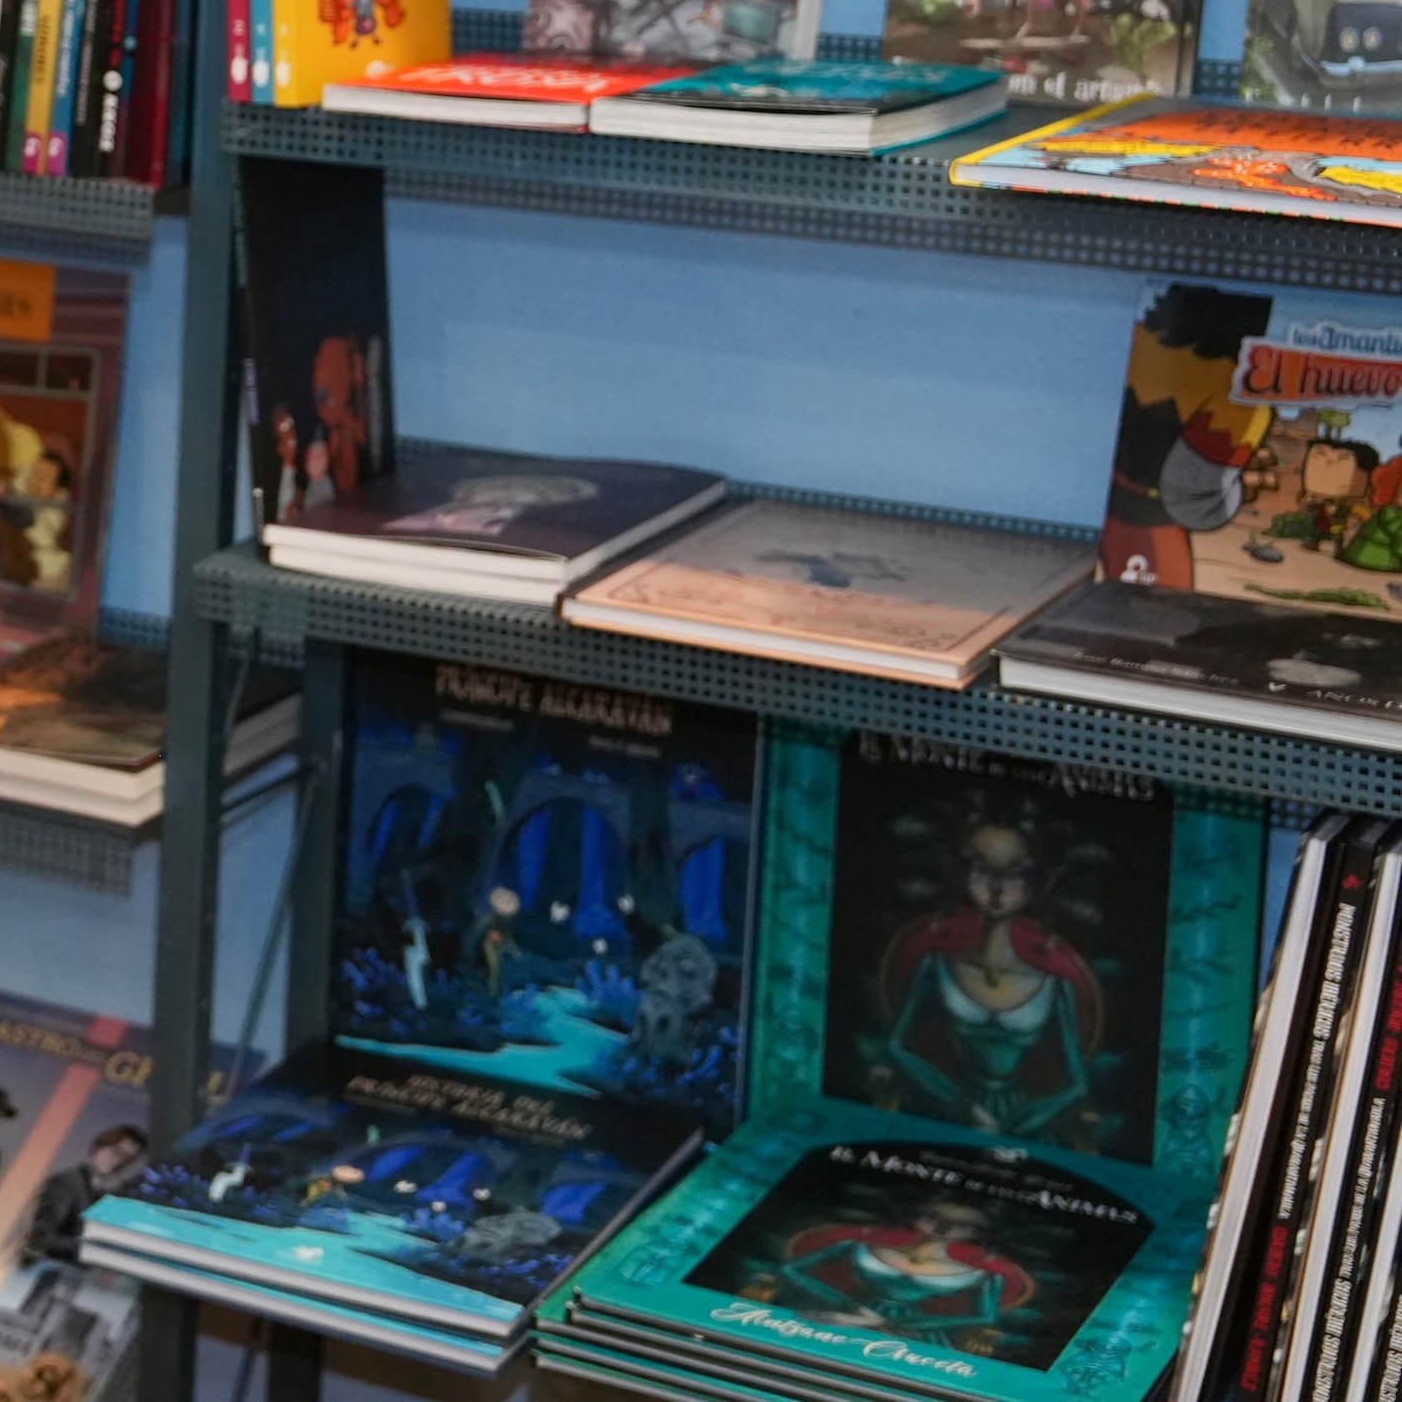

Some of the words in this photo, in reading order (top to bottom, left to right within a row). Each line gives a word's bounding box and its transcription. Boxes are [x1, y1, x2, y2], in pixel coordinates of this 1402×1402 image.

[1242, 344, 1282, 394] El
[1325, 901, 1356, 983] MONSTRUOS
[862, 1150, 961, 1185] MONTE
